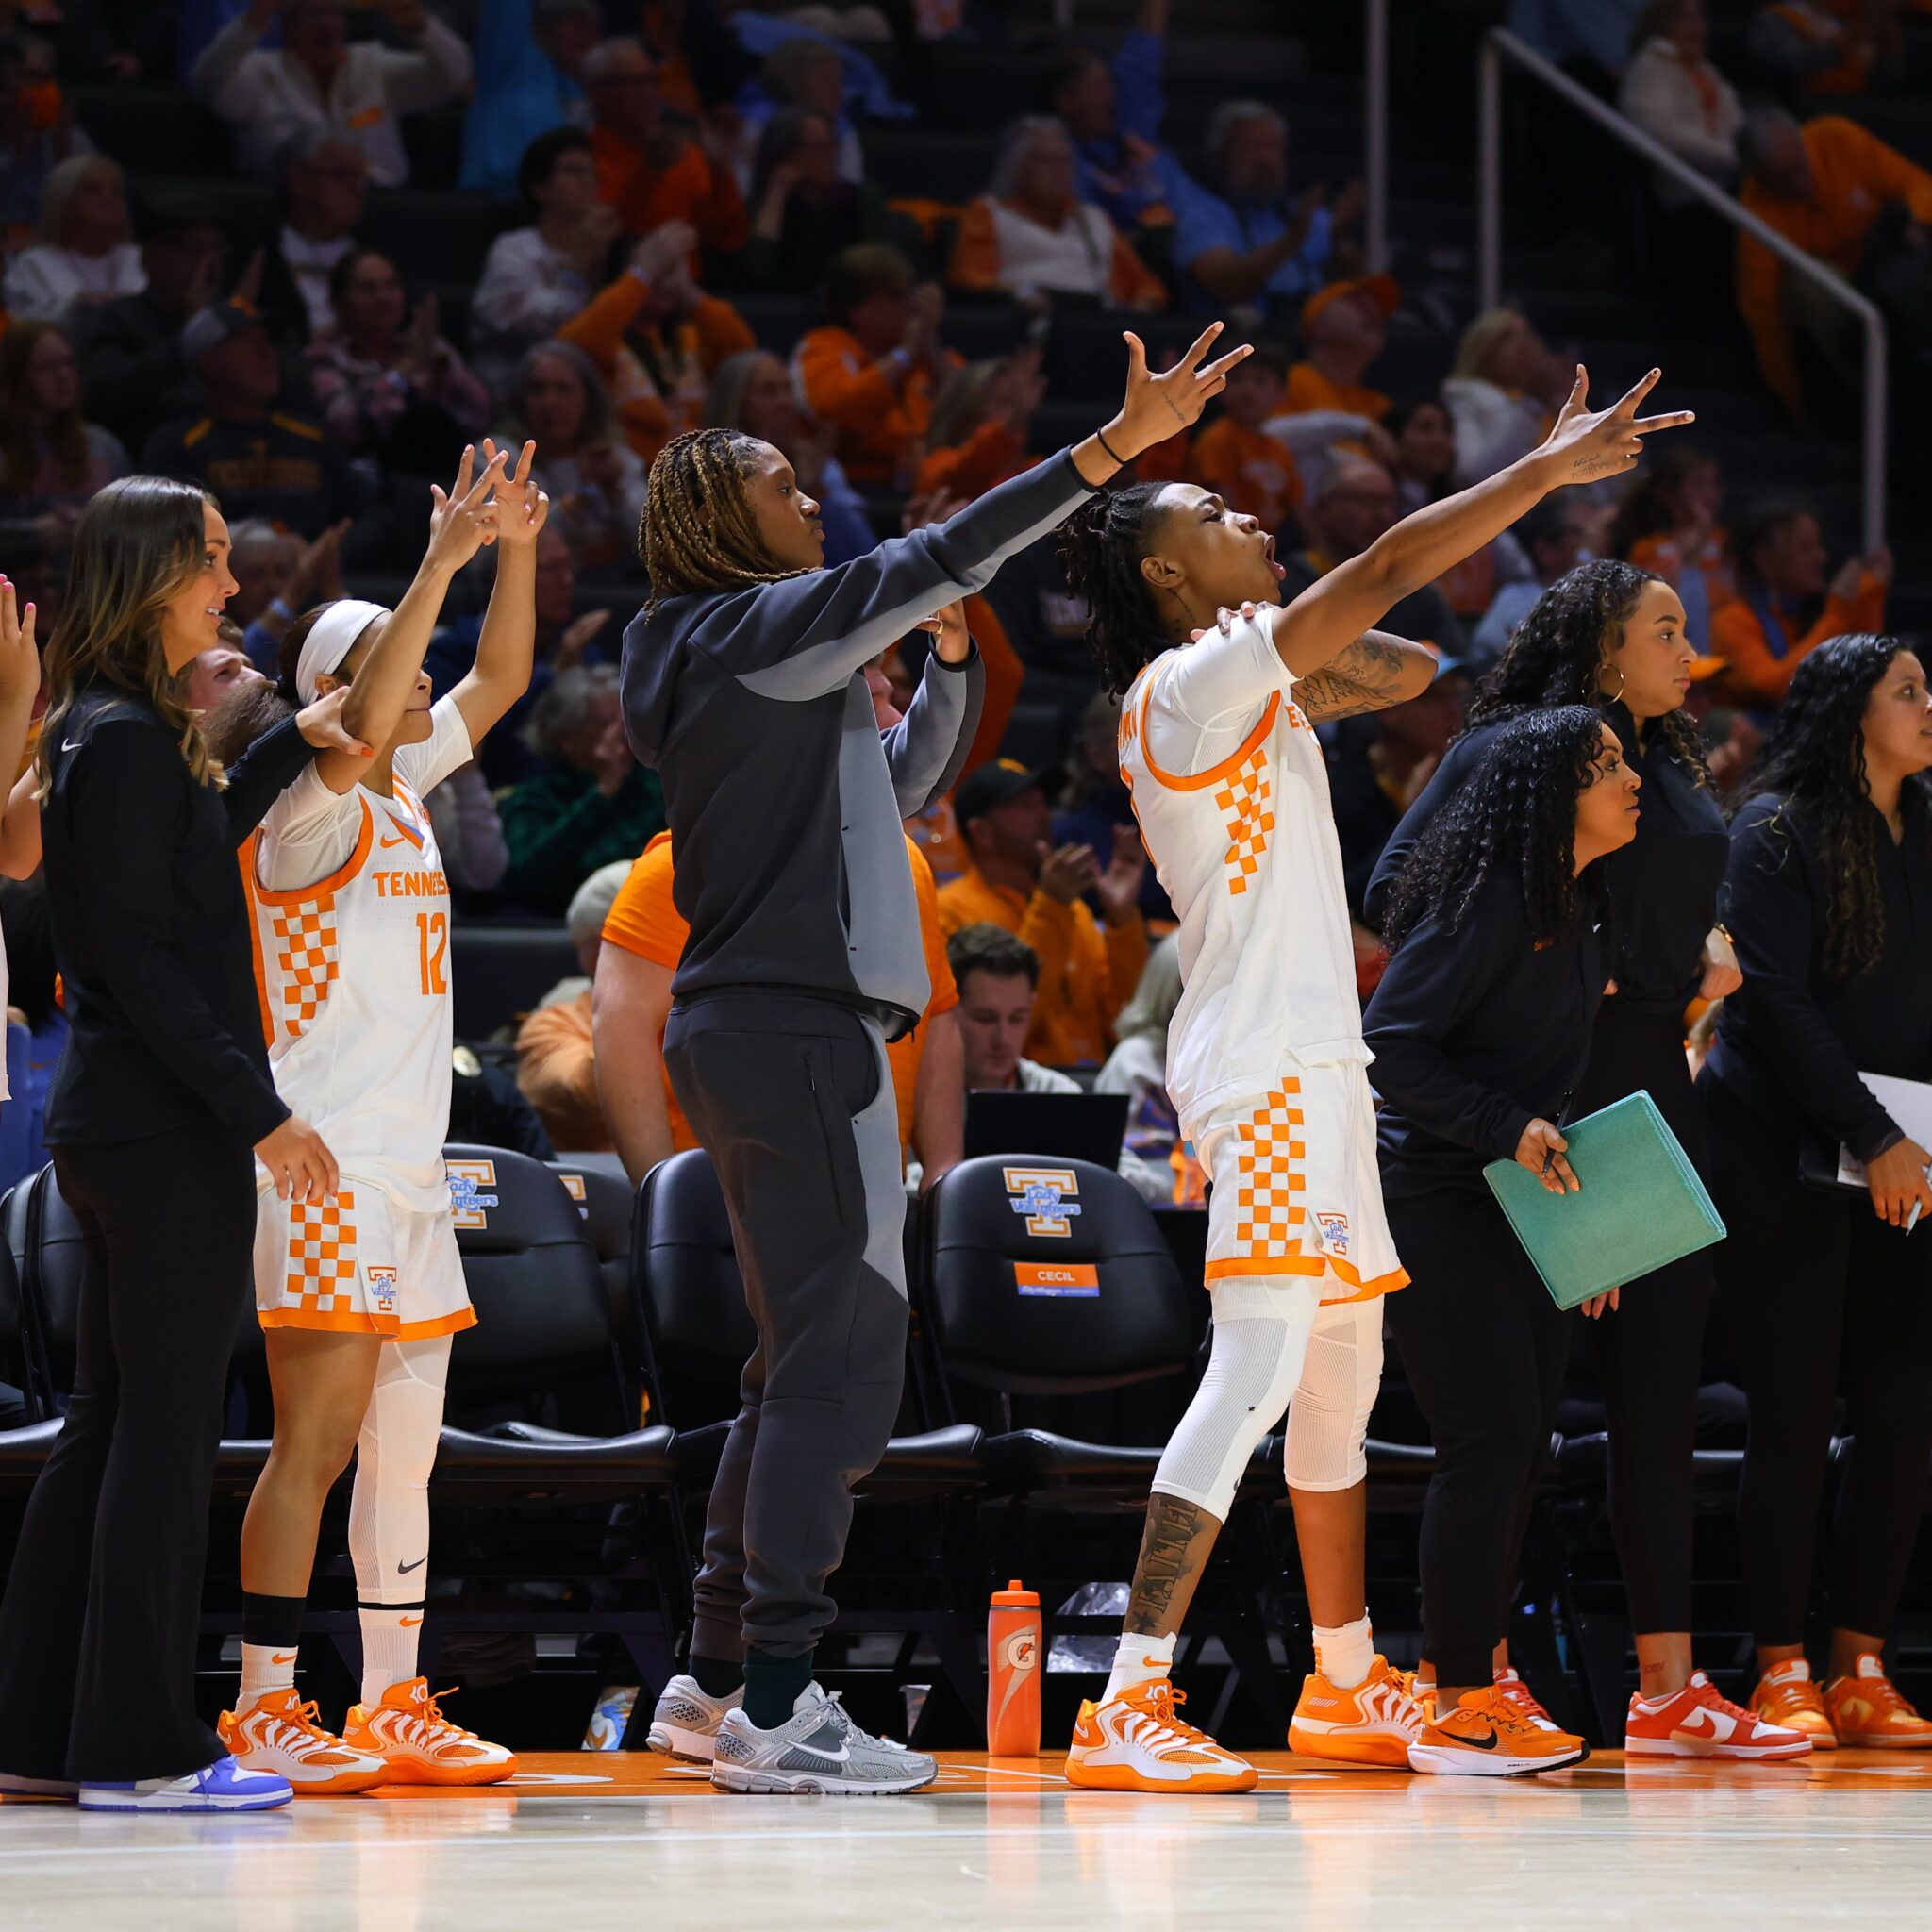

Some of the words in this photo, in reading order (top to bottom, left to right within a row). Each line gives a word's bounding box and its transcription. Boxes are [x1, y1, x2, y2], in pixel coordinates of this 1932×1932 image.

[415, 911, 447, 995] 12
[448, 1176, 476, 1196] ady
[453, 1194, 498, 1211] nteers
[1037, 1271, 1075, 1283] CECIL
